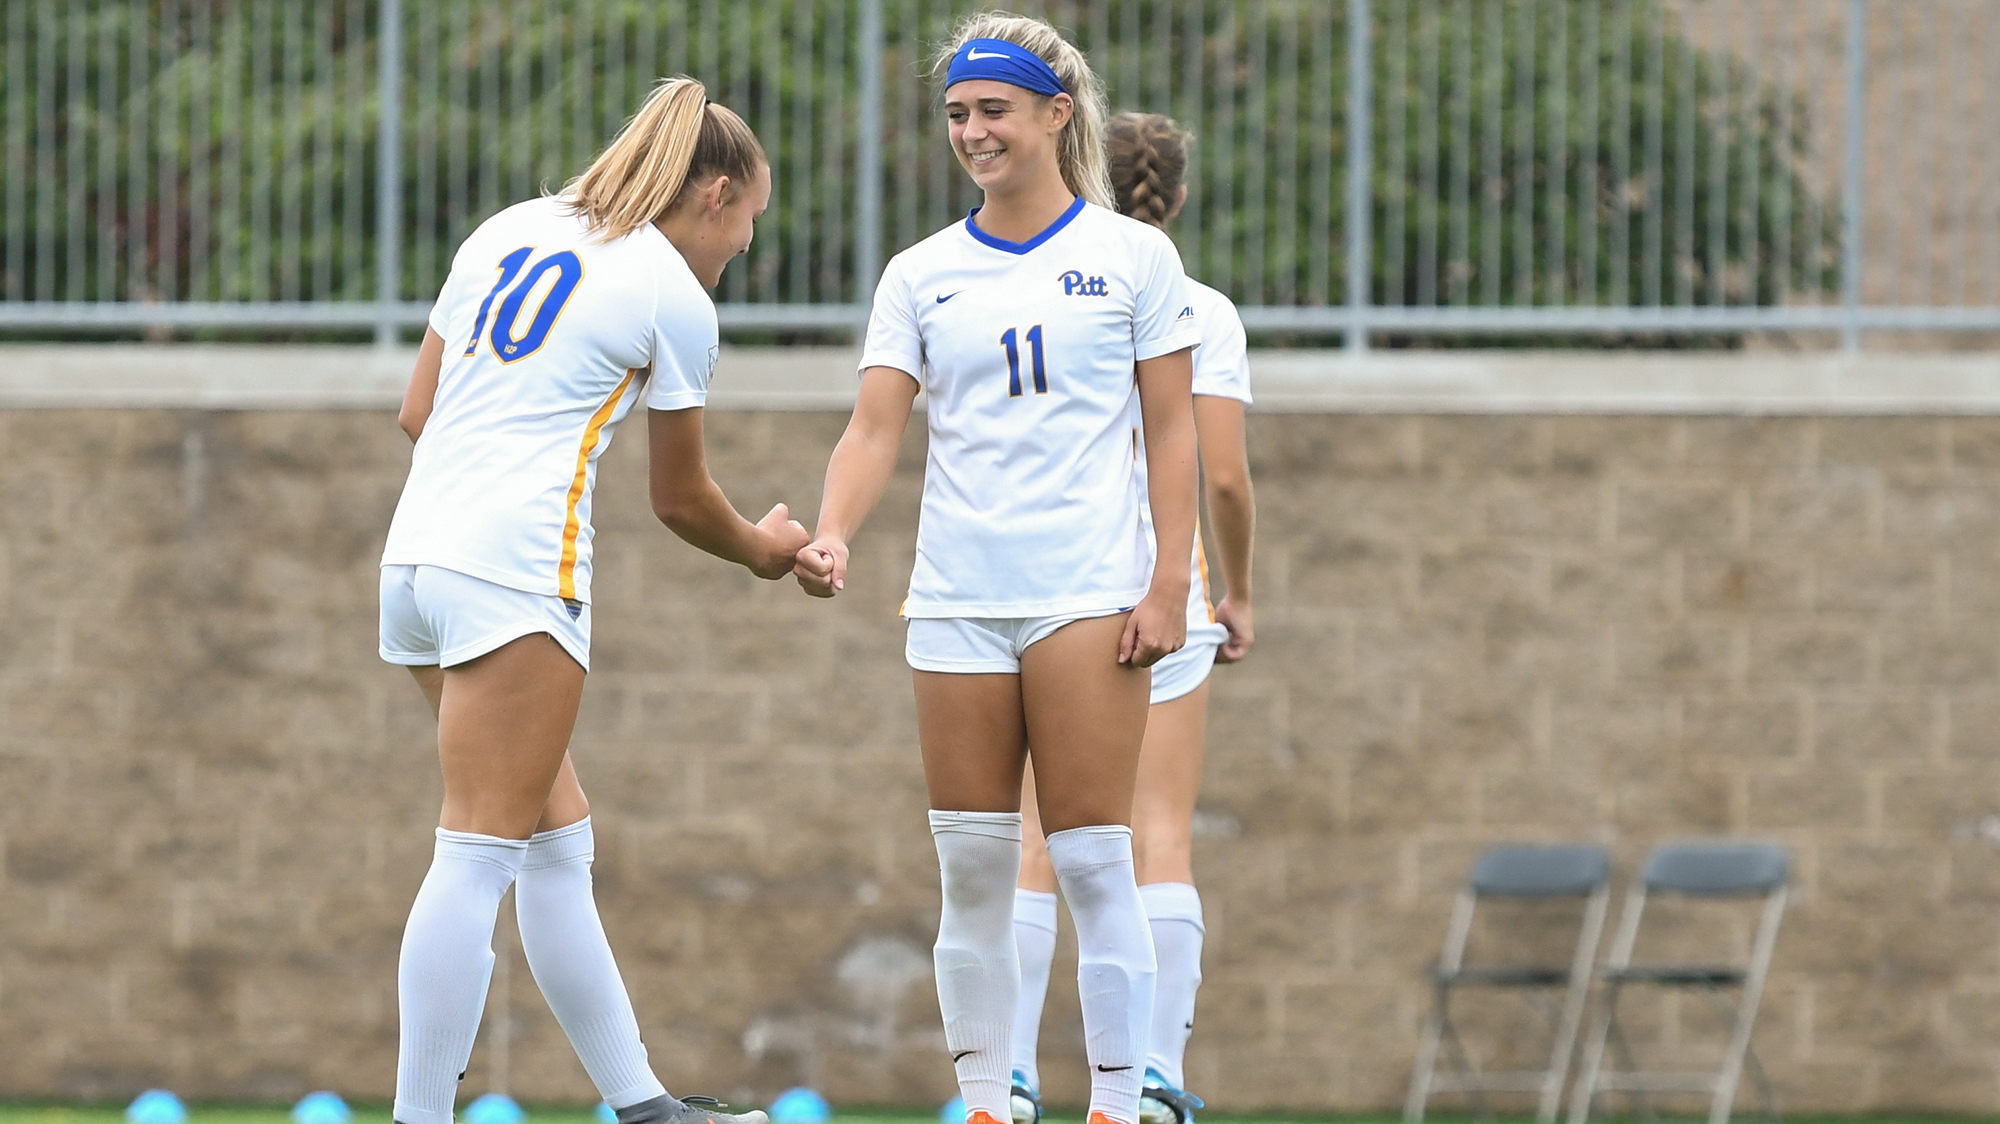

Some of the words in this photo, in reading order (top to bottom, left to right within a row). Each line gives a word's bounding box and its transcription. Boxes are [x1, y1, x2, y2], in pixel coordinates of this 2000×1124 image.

[463, 245, 586, 366] 10
[1057, 269, 1109, 297] Pitt
[1000, 324, 1049, 398] 11
